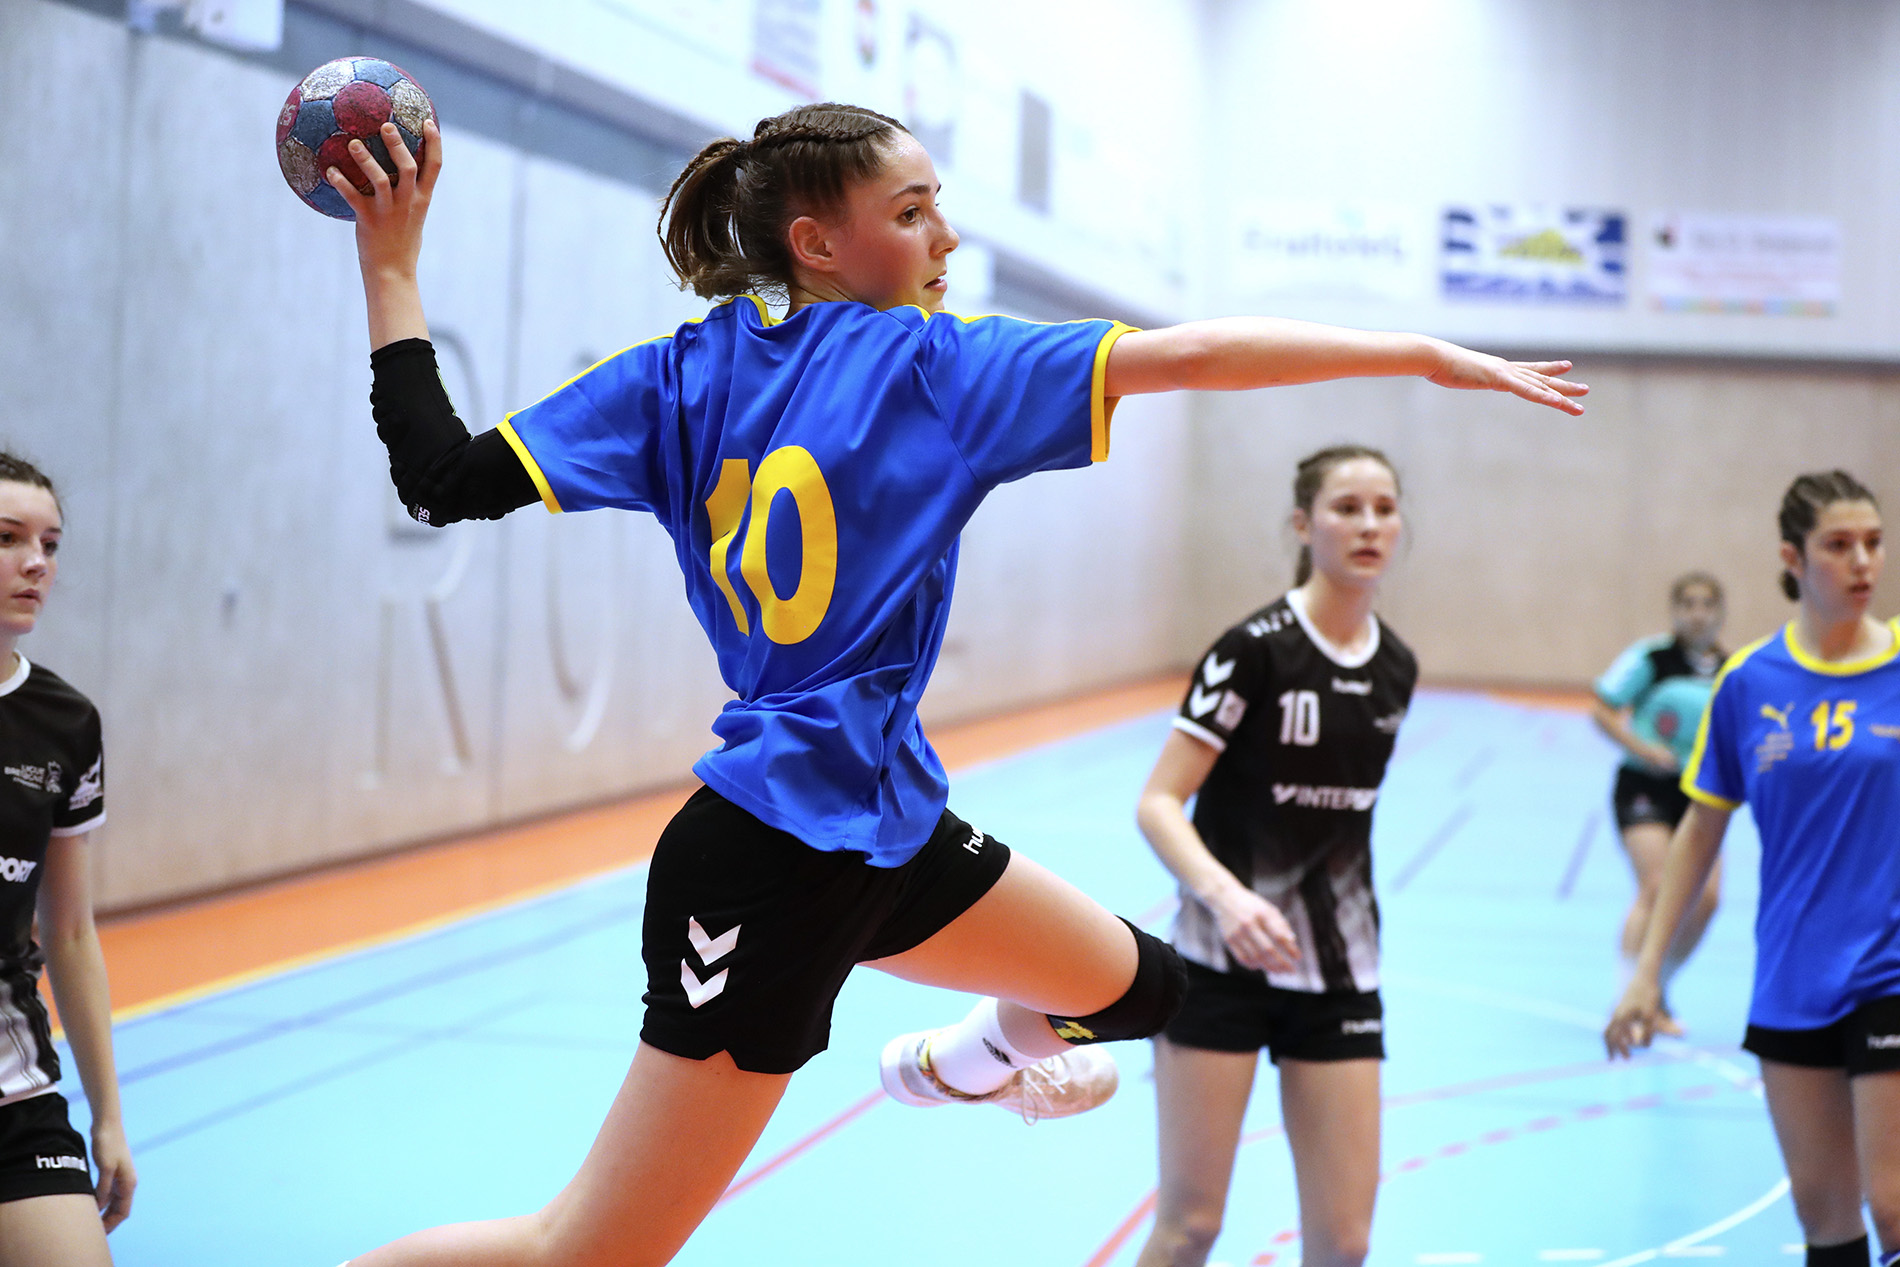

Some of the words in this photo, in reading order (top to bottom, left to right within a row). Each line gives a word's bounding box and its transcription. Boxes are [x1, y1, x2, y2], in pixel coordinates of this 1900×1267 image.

[705, 446, 838, 645] 10
[1279, 690, 1320, 746] 10
[1810, 699, 1858, 751] 15
